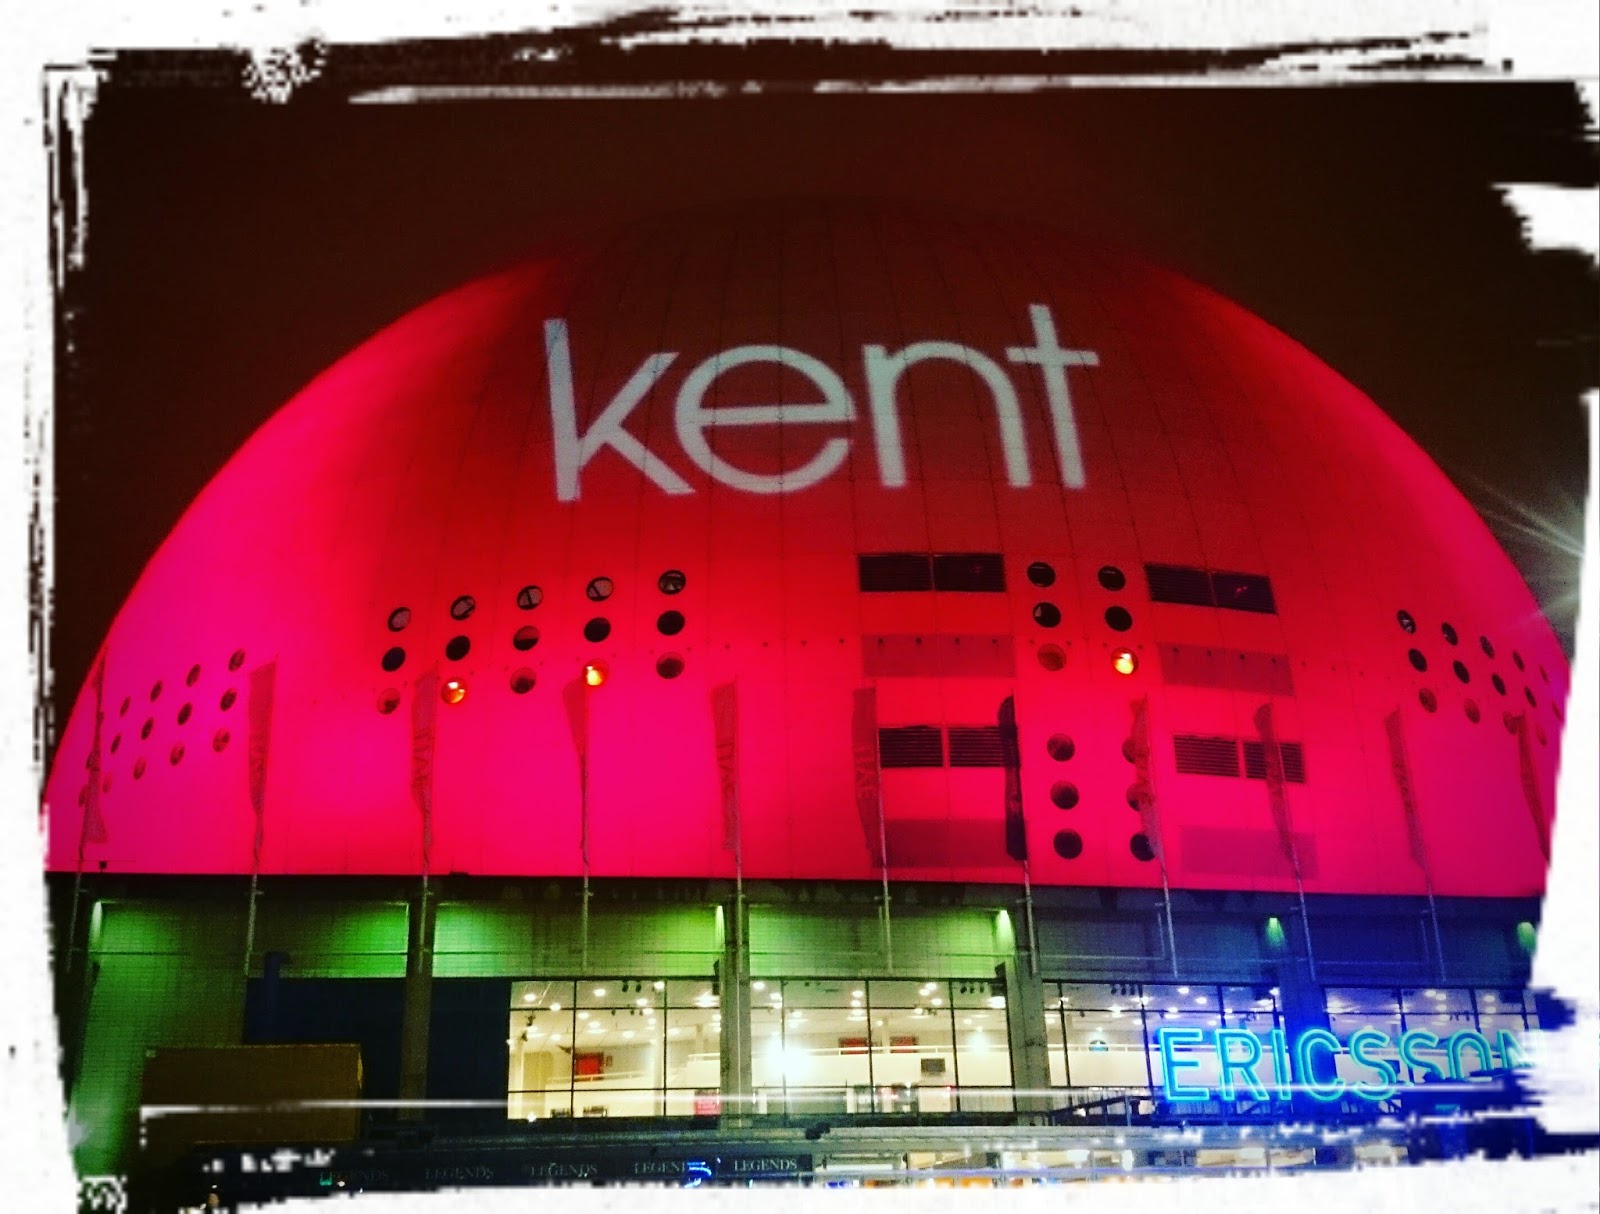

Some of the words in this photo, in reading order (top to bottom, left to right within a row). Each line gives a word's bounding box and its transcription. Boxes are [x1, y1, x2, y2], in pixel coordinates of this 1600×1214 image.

[543, 303, 1099, 502] kent
[530, 1163, 598, 1177] LEGENDS
[733, 1158, 797, 1171] LEGENDS
[425, 1167, 494, 1180] LEGENDS
